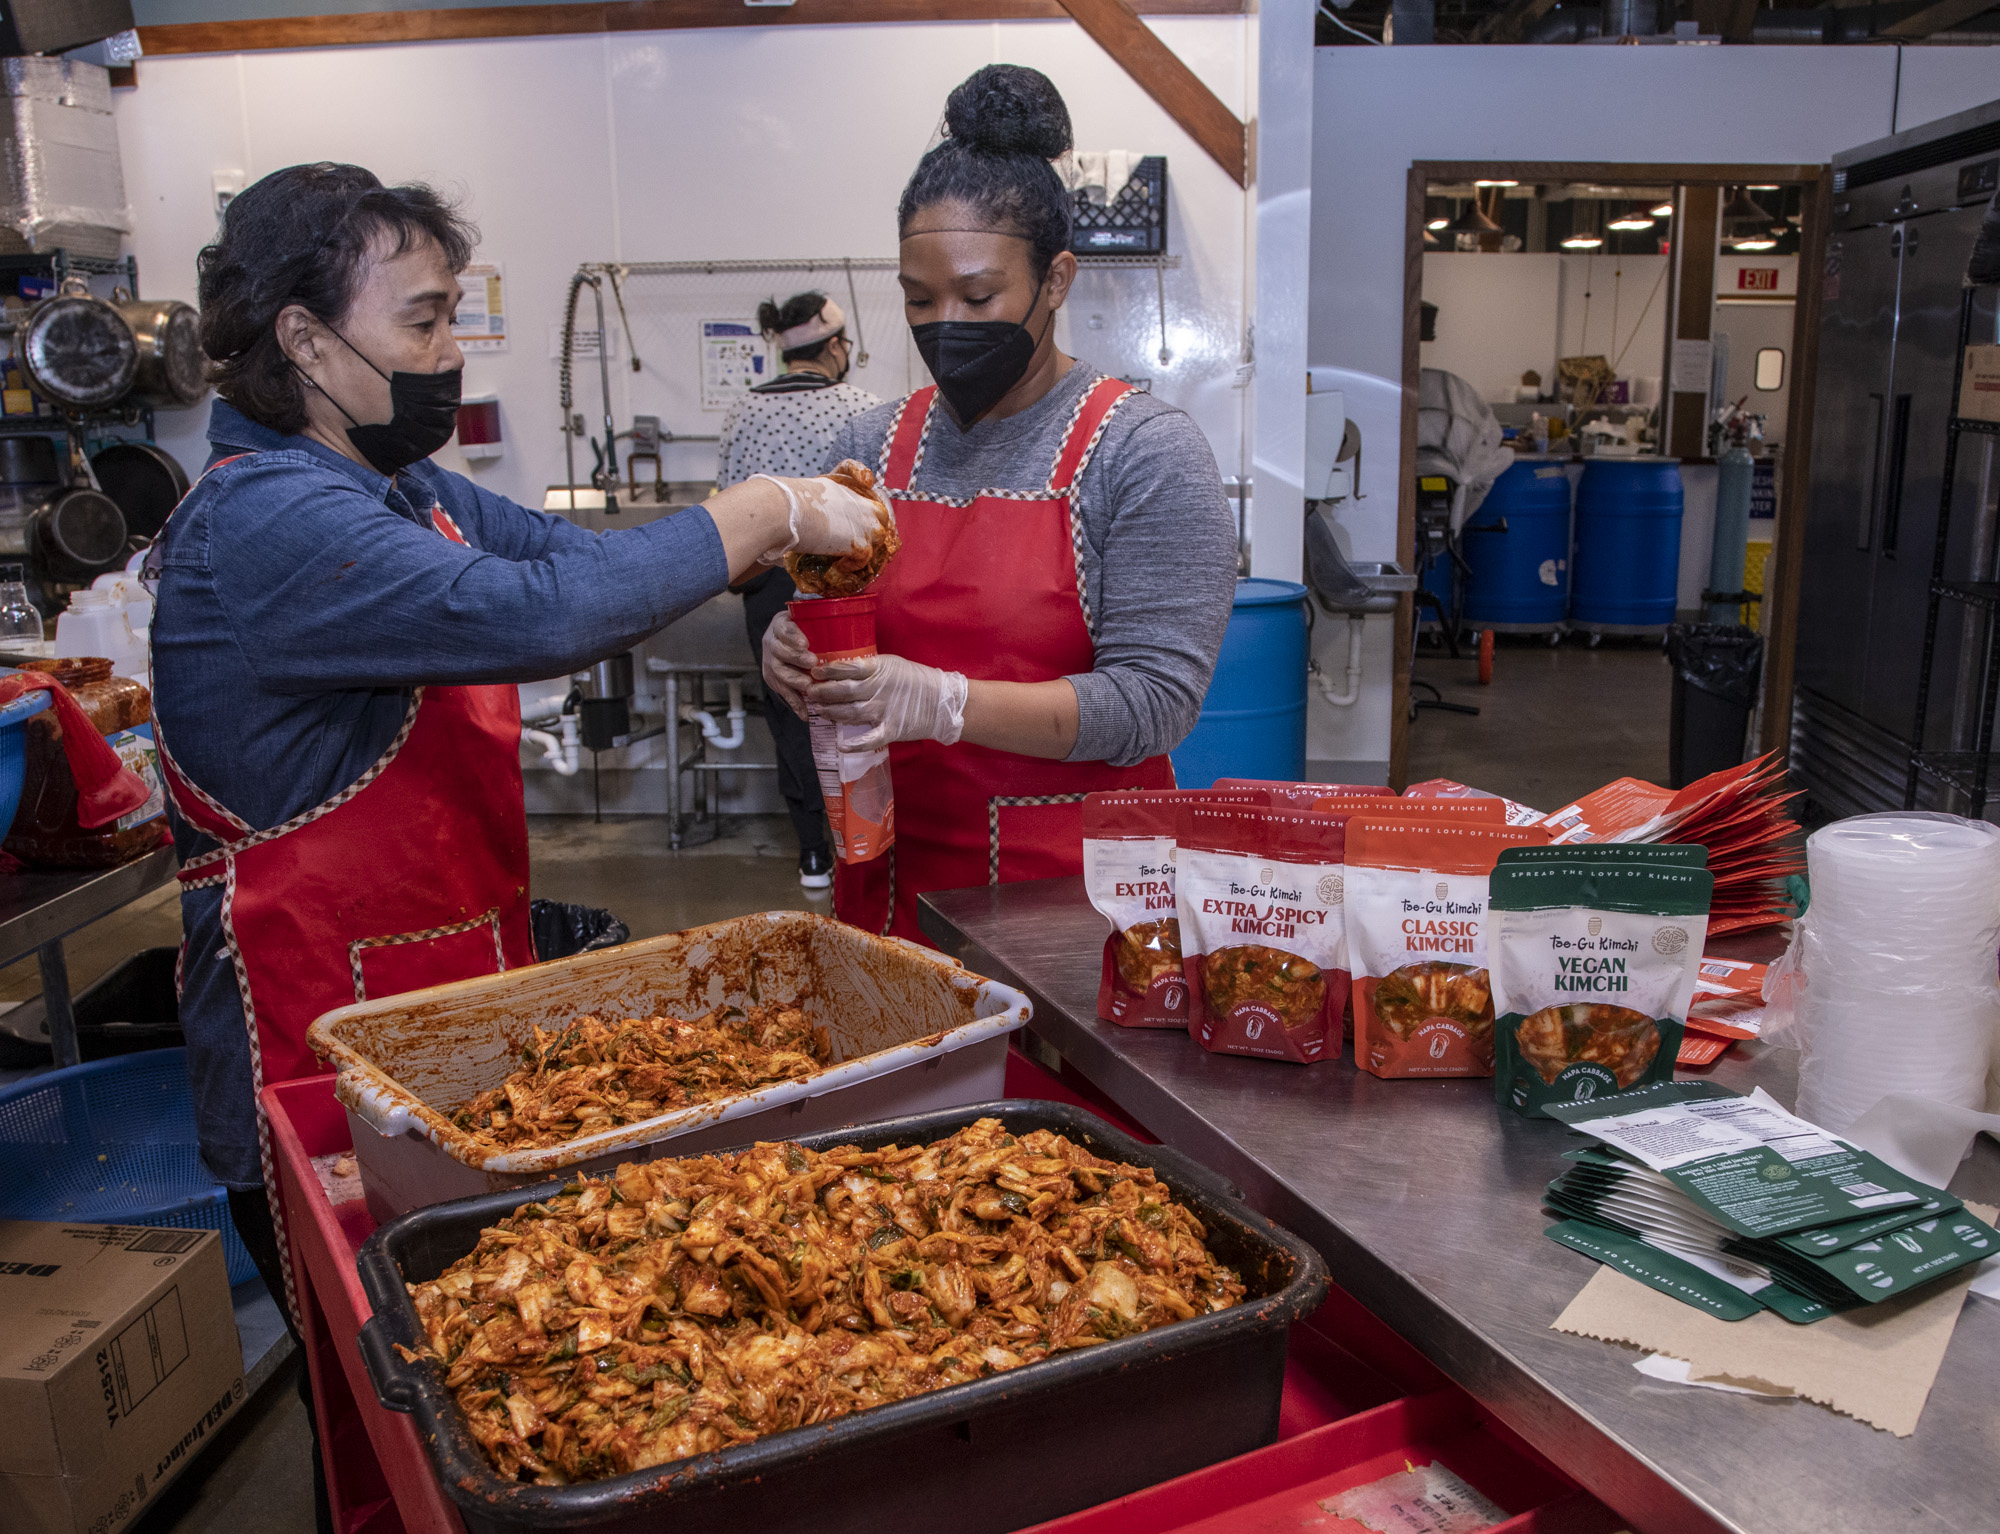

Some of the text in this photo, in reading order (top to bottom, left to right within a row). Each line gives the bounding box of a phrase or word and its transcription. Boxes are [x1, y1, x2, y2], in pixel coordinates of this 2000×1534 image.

[1745, 270, 1772, 290] EXIT
[1194, 809, 1232, 818] SPREAD
[1261, 814, 1286, 823] LOVE
[1310, 819, 1344, 827] KIMCH
[1437, 828, 1463, 836] LOVE
[1489, 831, 1529, 840] KIMCHI
[1511, 870, 1555, 878] SPREAD
[1649, 873, 1693, 882] KIMCHI
[1115, 881, 1171, 897] EXTRA
[1270, 886, 1302, 902] Kimchi
[1145, 895, 1176, 910] KIM
[1446, 901, 1482, 915] Kimchi
[1202, 898, 1328, 925] EXTRA SPICY
[1231, 917, 1295, 938] KIMCHI
[1401, 918, 1479, 937] CLASSIC
[1406, 936, 1474, 953] KIMCHI
[1599, 936, 1639, 952] Kimchi
[1558, 956, 1626, 974] VEGAN
[1152, 977, 1169, 989] NAPA
[1554, 974, 1628, 992] KIMCHI
[1234, 1005, 1279, 1023] NAPA CABBAGE
[1418, 1022, 1465, 1039] NAPA CABBAGE
[1561, 1067, 1613, 1084] NAPA CABBAGE
[1557, 1099, 1595, 1108] SPREAD
[1562, 1233, 1723, 1309] SPREAD THE LOVE OF KIMCHI
[96, 1347, 119, 1430] YL2512
